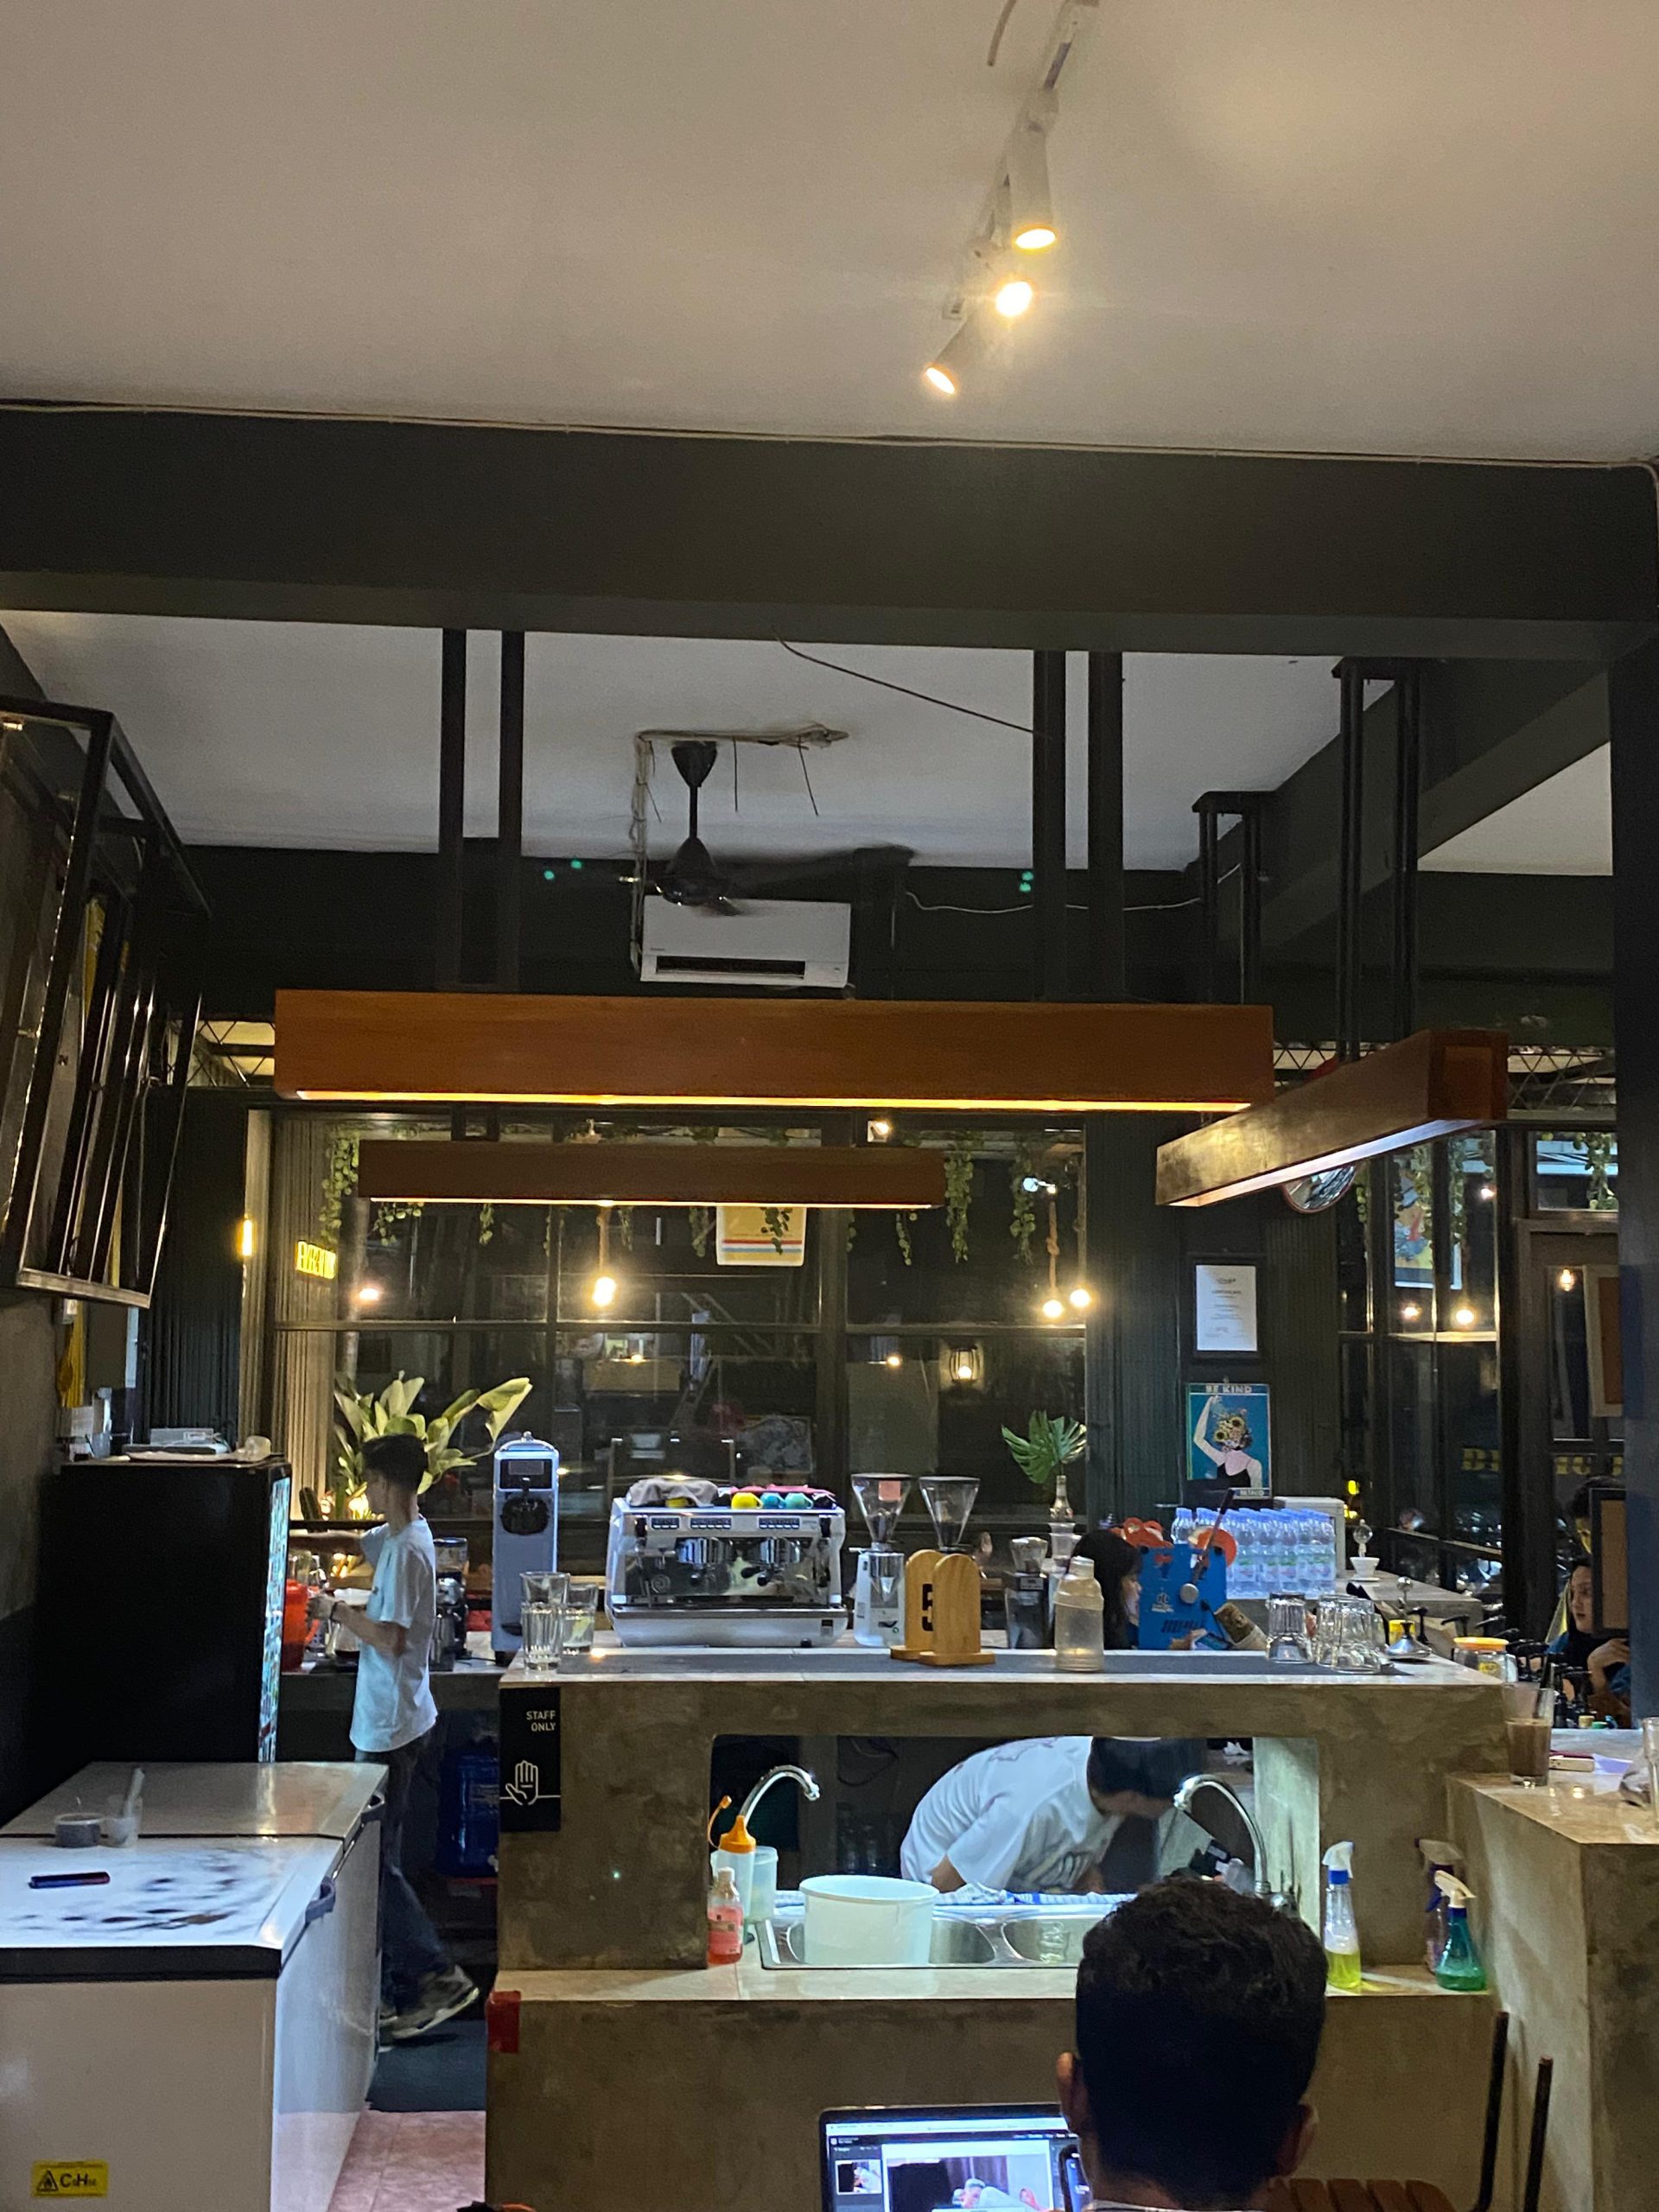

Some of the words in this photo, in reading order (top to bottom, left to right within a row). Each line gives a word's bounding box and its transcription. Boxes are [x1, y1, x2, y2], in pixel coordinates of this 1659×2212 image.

[1205, 1384, 1218, 1393] BE
[1223, 1384, 1252, 1393] KIND
[526, 1710, 556, 1720] STAFF
[531, 1722, 556, 1732] ONLY
